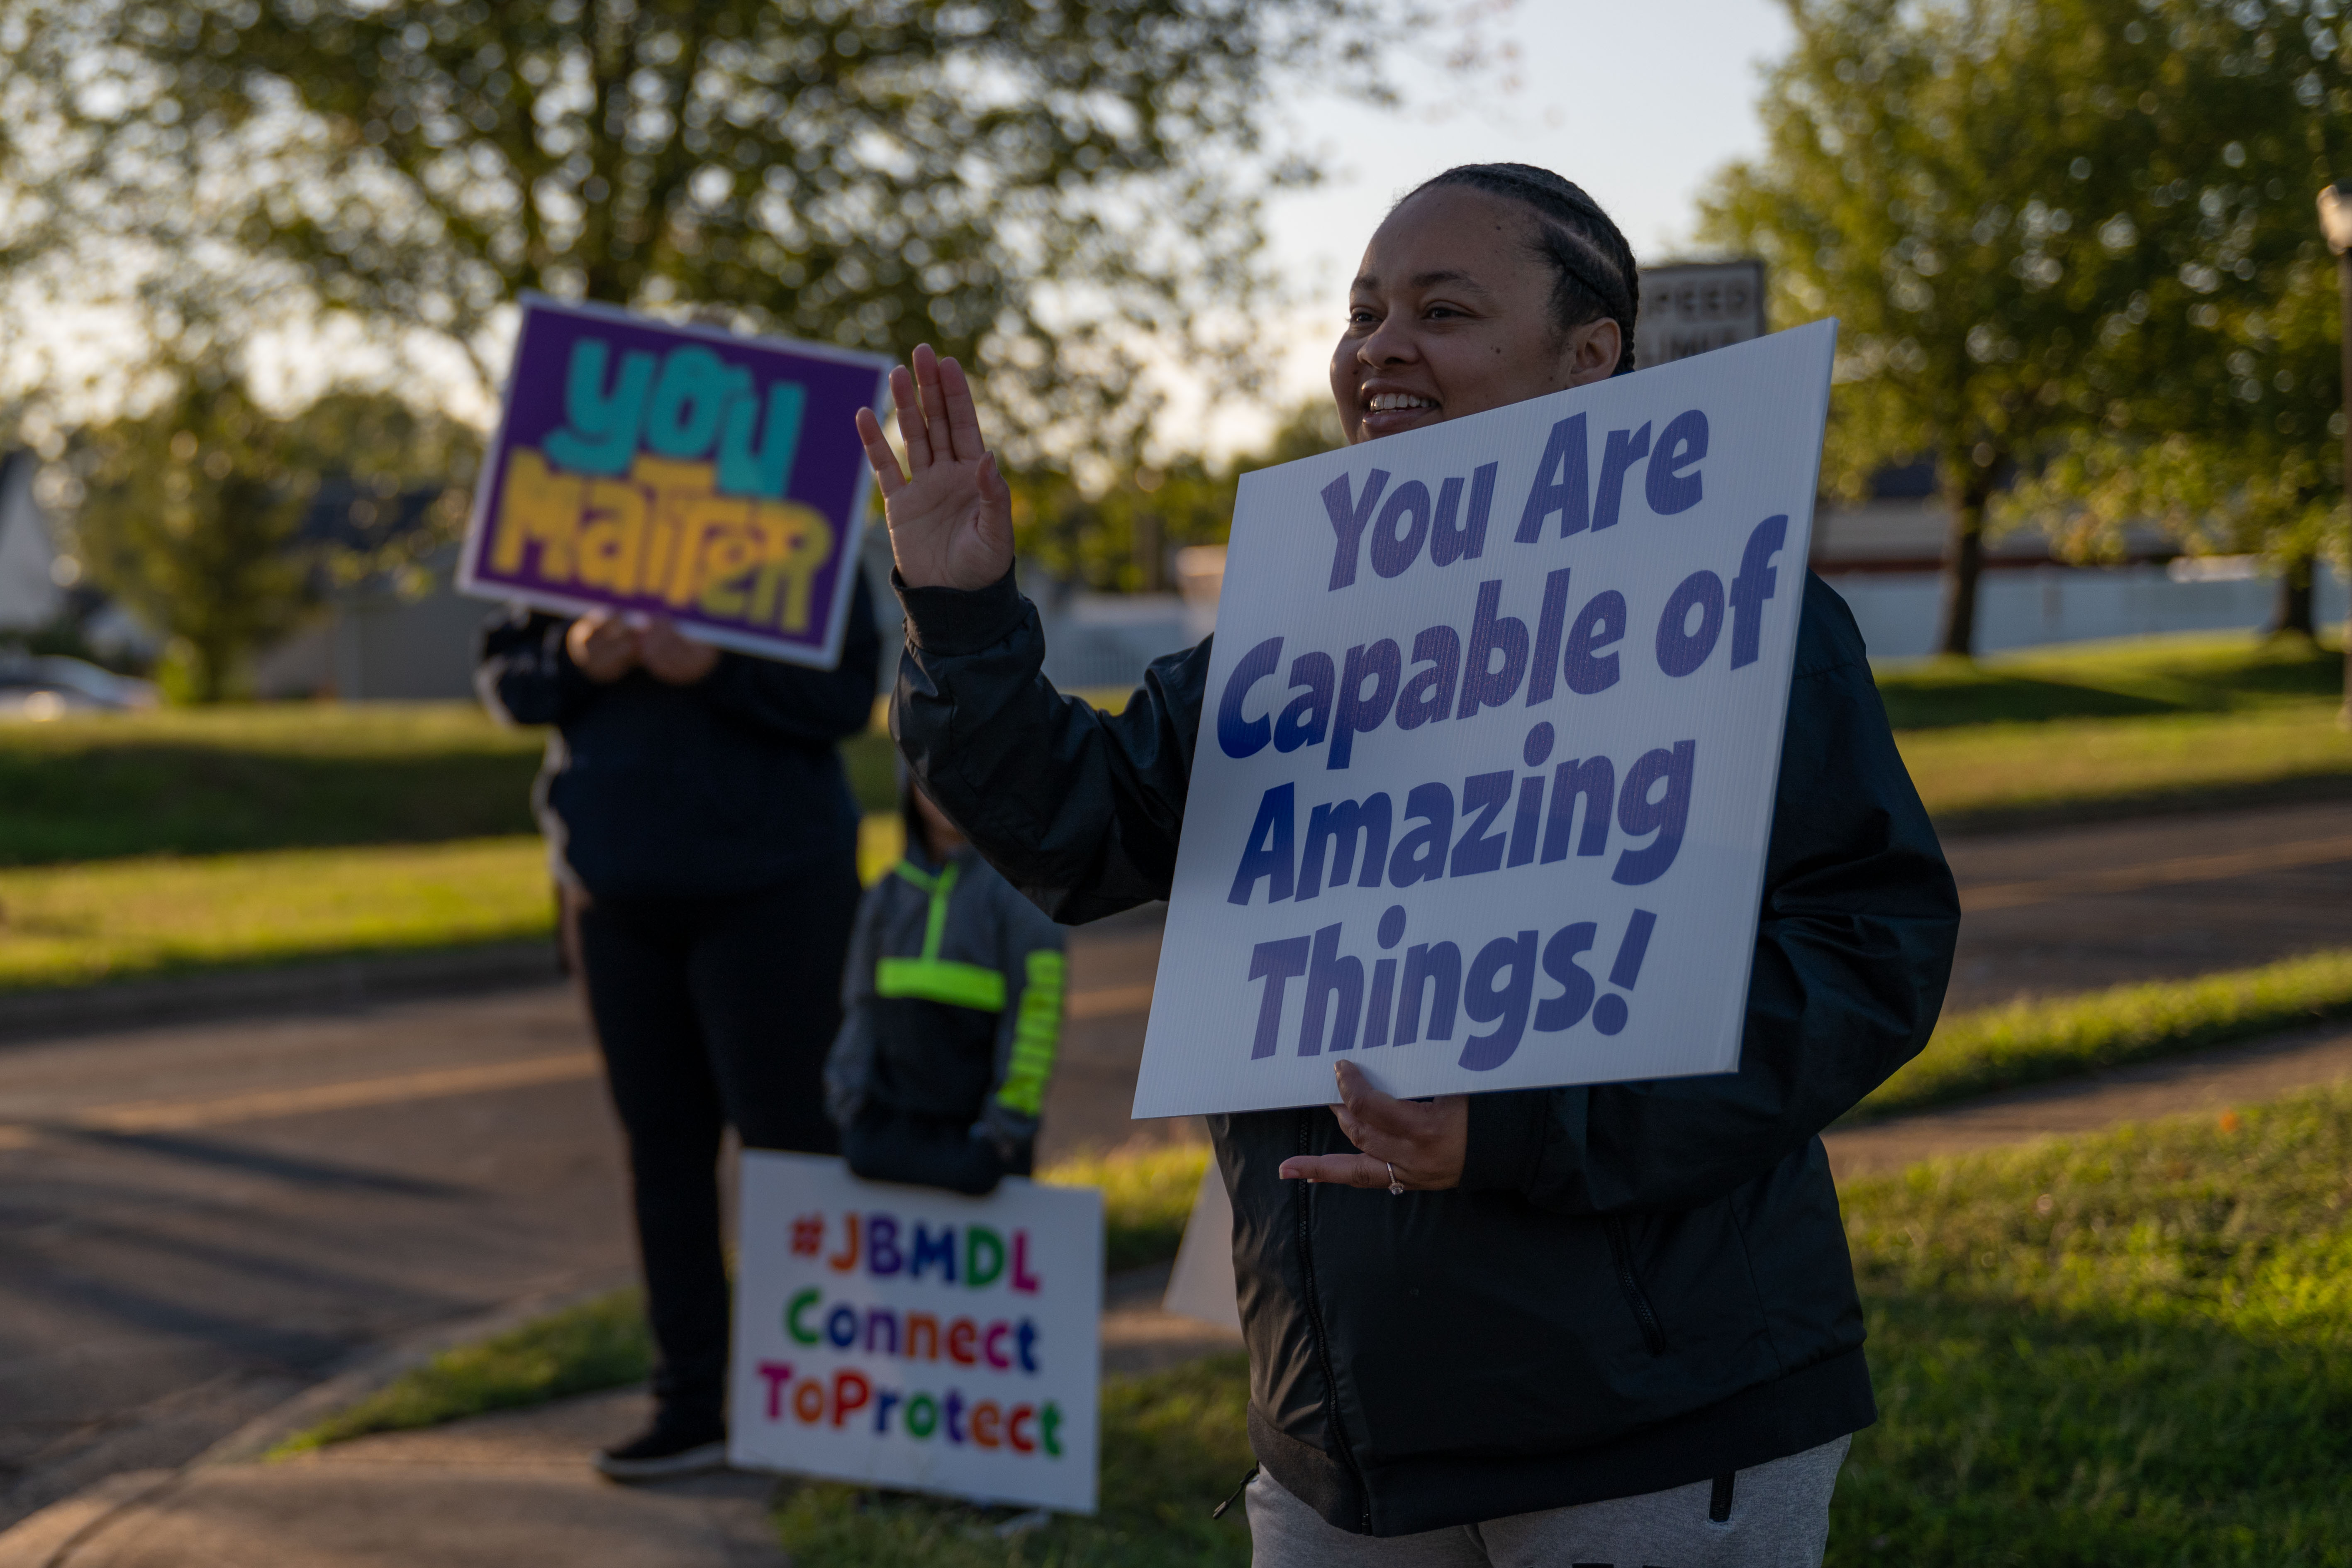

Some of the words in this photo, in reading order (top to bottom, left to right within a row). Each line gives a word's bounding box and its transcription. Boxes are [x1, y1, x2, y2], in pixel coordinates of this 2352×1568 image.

[1321, 461, 1499, 592] You
[1514, 411, 1709, 544] Are
[1216, 567, 1627, 771] Capable
[1655, 514, 1789, 678] of
[1227, 721, 1696, 906] Amazing
[1248, 904, 1657, 1072] Things!
[785, 1286, 1039, 1374] Connect
[787, 1212, 1041, 1294] #JBMDL
[757, 1361, 1063, 1457] ToProtect
